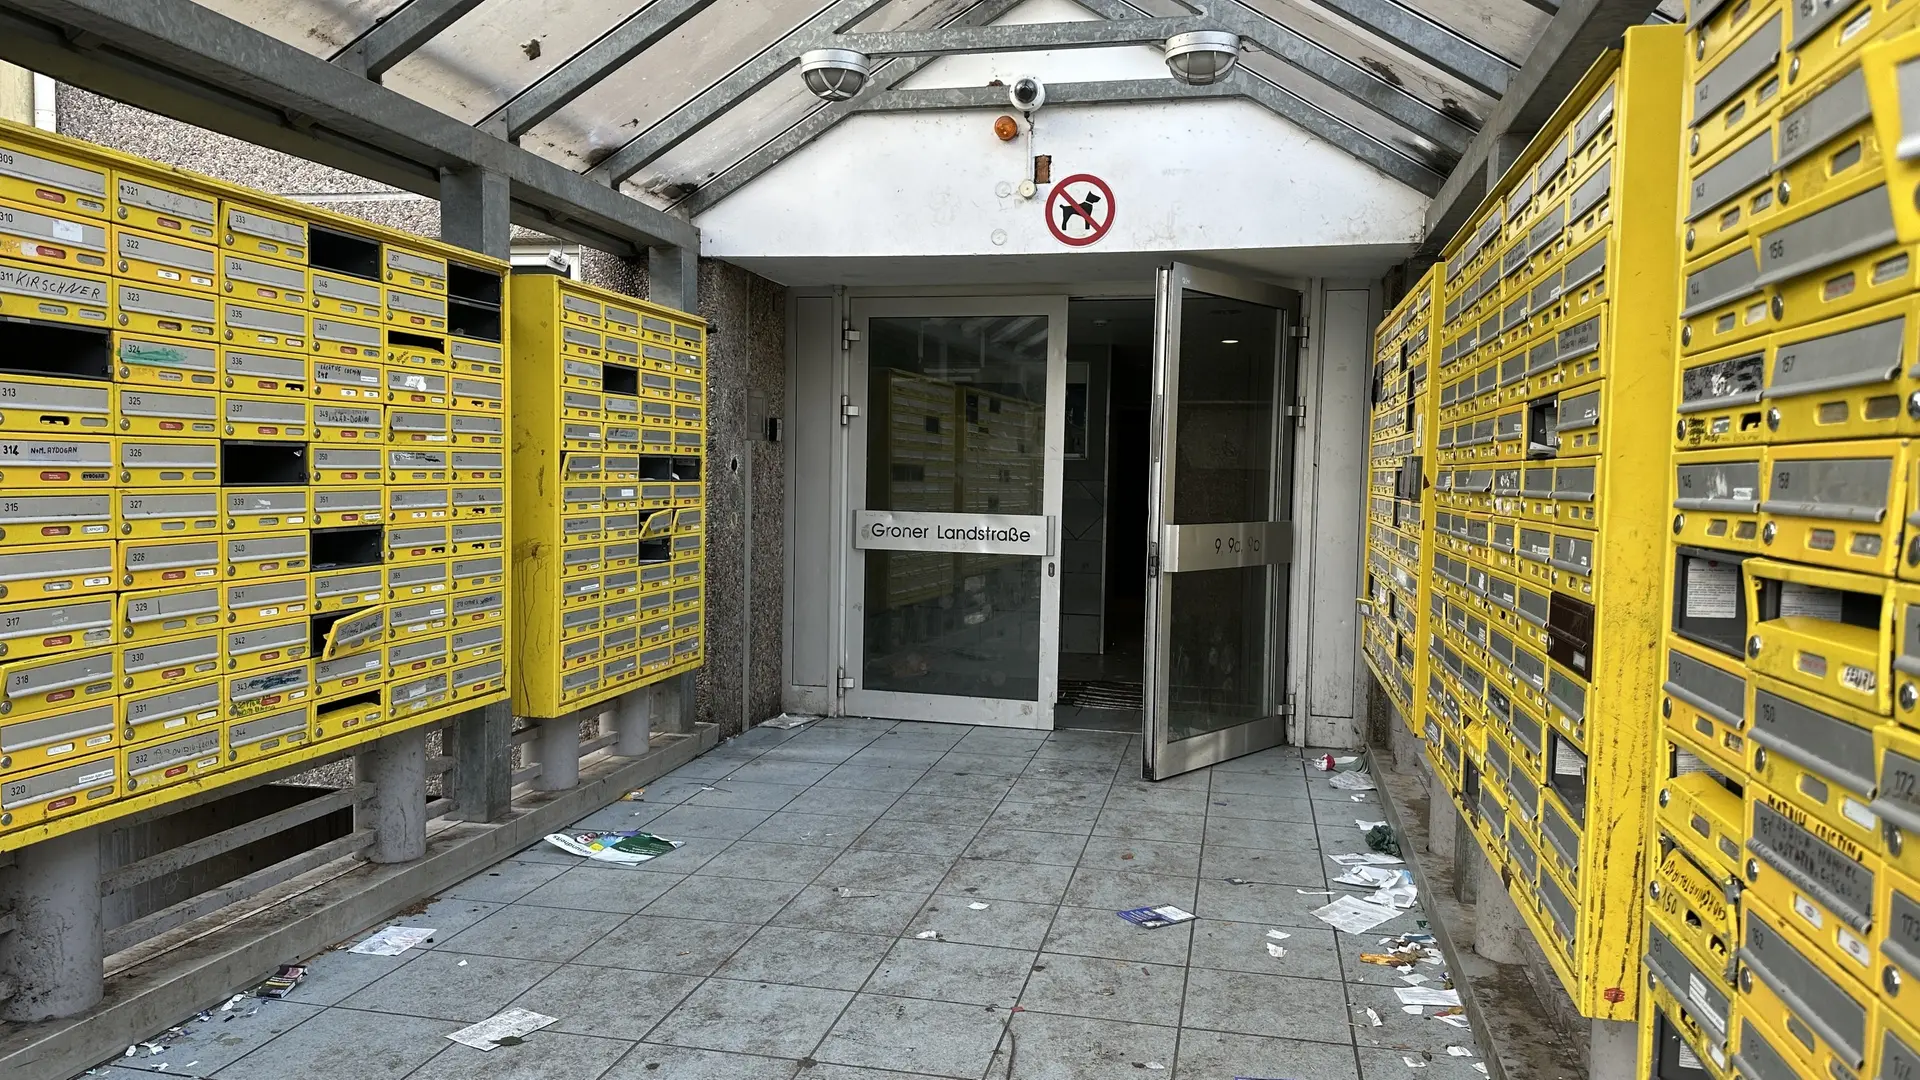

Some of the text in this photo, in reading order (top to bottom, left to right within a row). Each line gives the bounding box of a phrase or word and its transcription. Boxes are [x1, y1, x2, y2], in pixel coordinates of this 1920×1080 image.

[126, 185, 139, 196] 321
[235, 214, 245, 224] 333
[126, 239, 139, 249] 322
[231, 261, 242, 271] 334
[0, 271, 14, 282] 311
[15, 271, 101, 299] KIRSCHNER
[127, 292, 140, 302] 323
[231, 309, 242, 318] 335
[128, 344, 141, 354] 324
[231, 356, 242, 366] 336
[2, 387, 17, 397] 313
[128, 396, 141, 406] 325
[232, 404, 243, 412] 337
[3, 444, 19, 456] 314
[47, 446, 78, 455] AYDOGAN
[129, 448, 142, 457] 326
[129, 500, 143, 509] 327
[233, 497, 244, 506] 339
[4, 502, 19, 512] 315
[871, 523, 1031, 542] Groner Landstraße
[234, 591, 245, 599] 341
[135, 602, 148, 612] 329
[6, 616, 20, 627] 317
[234, 636, 246, 645] 342
[131, 652, 144, 663] 330
[15, 674, 29, 686] 318
[135, 704, 147, 714] 331
[135, 753, 148, 764] 332
[11, 784, 26, 797] 320
